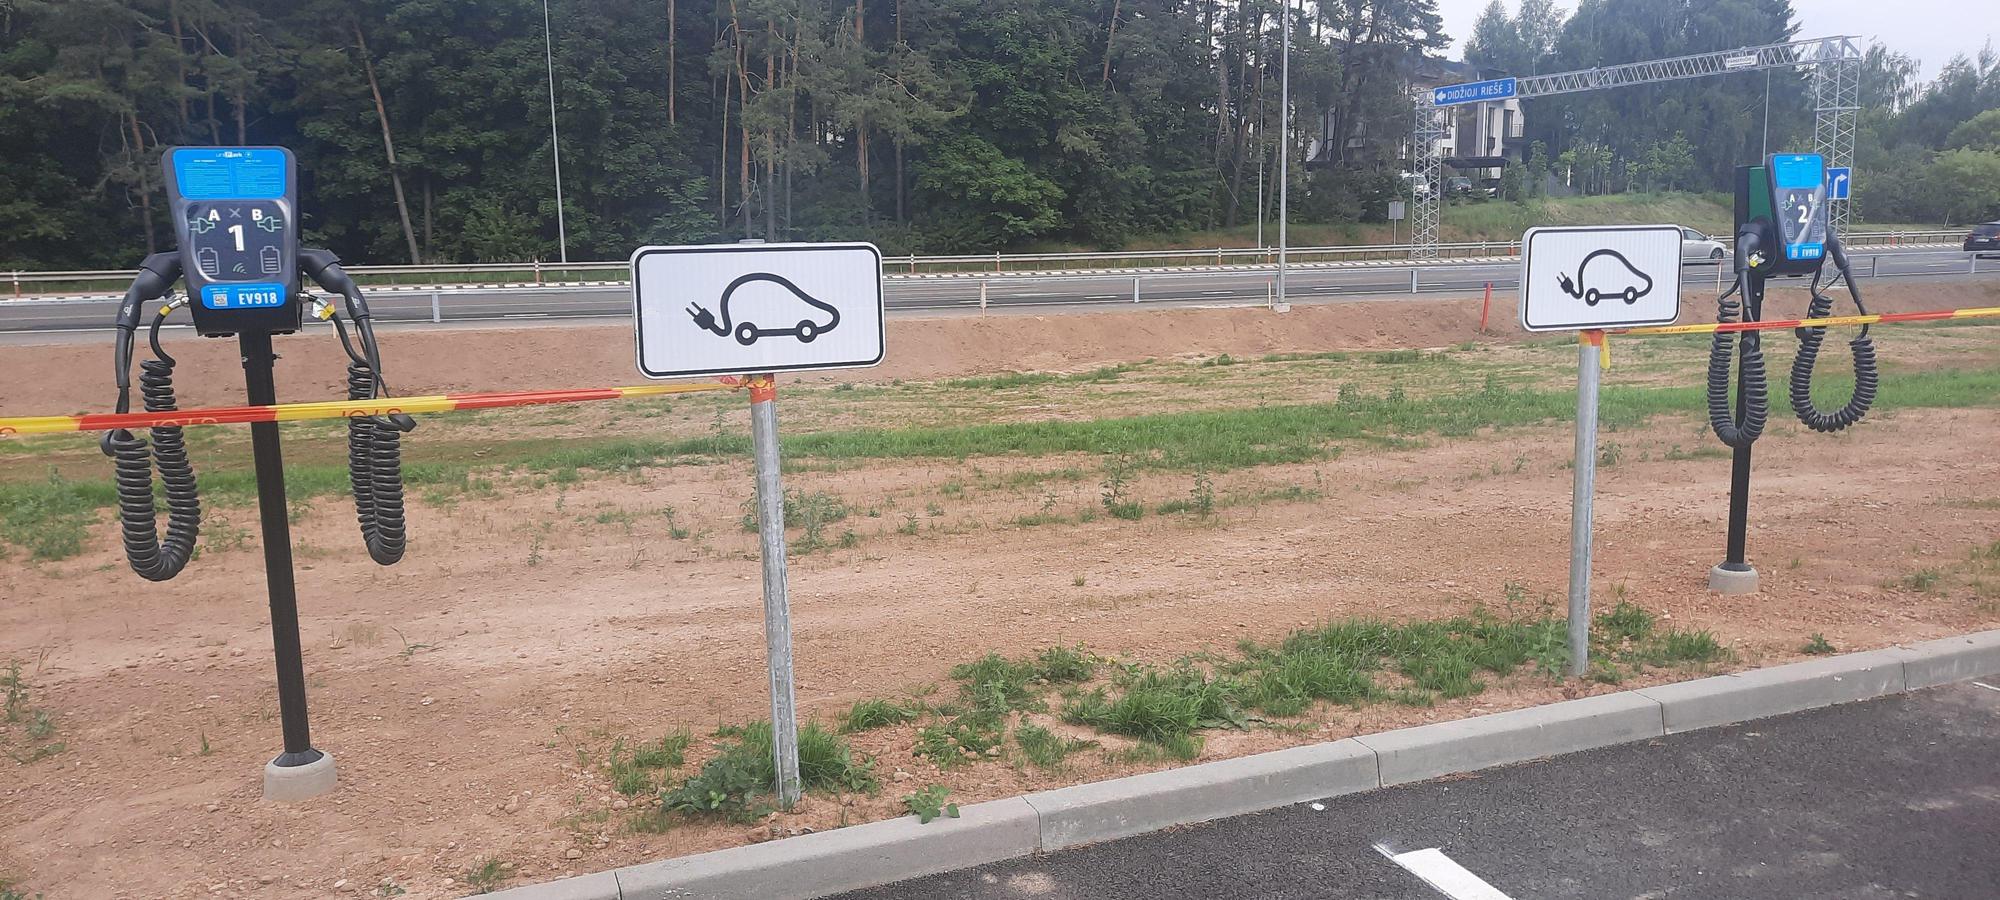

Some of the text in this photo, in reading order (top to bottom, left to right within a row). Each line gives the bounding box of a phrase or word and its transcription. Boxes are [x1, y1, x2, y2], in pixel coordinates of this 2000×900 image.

[1447, 87, 1478, 100] DIDŽIOJI
[1507, 83, 1512, 93] 3
[1789, 193, 1813, 203] A B
[208, 208, 263, 221] A B
[1797, 205, 1808, 223] 2
[228, 224, 245, 251] 1
[238, 292, 278, 305] EV918
